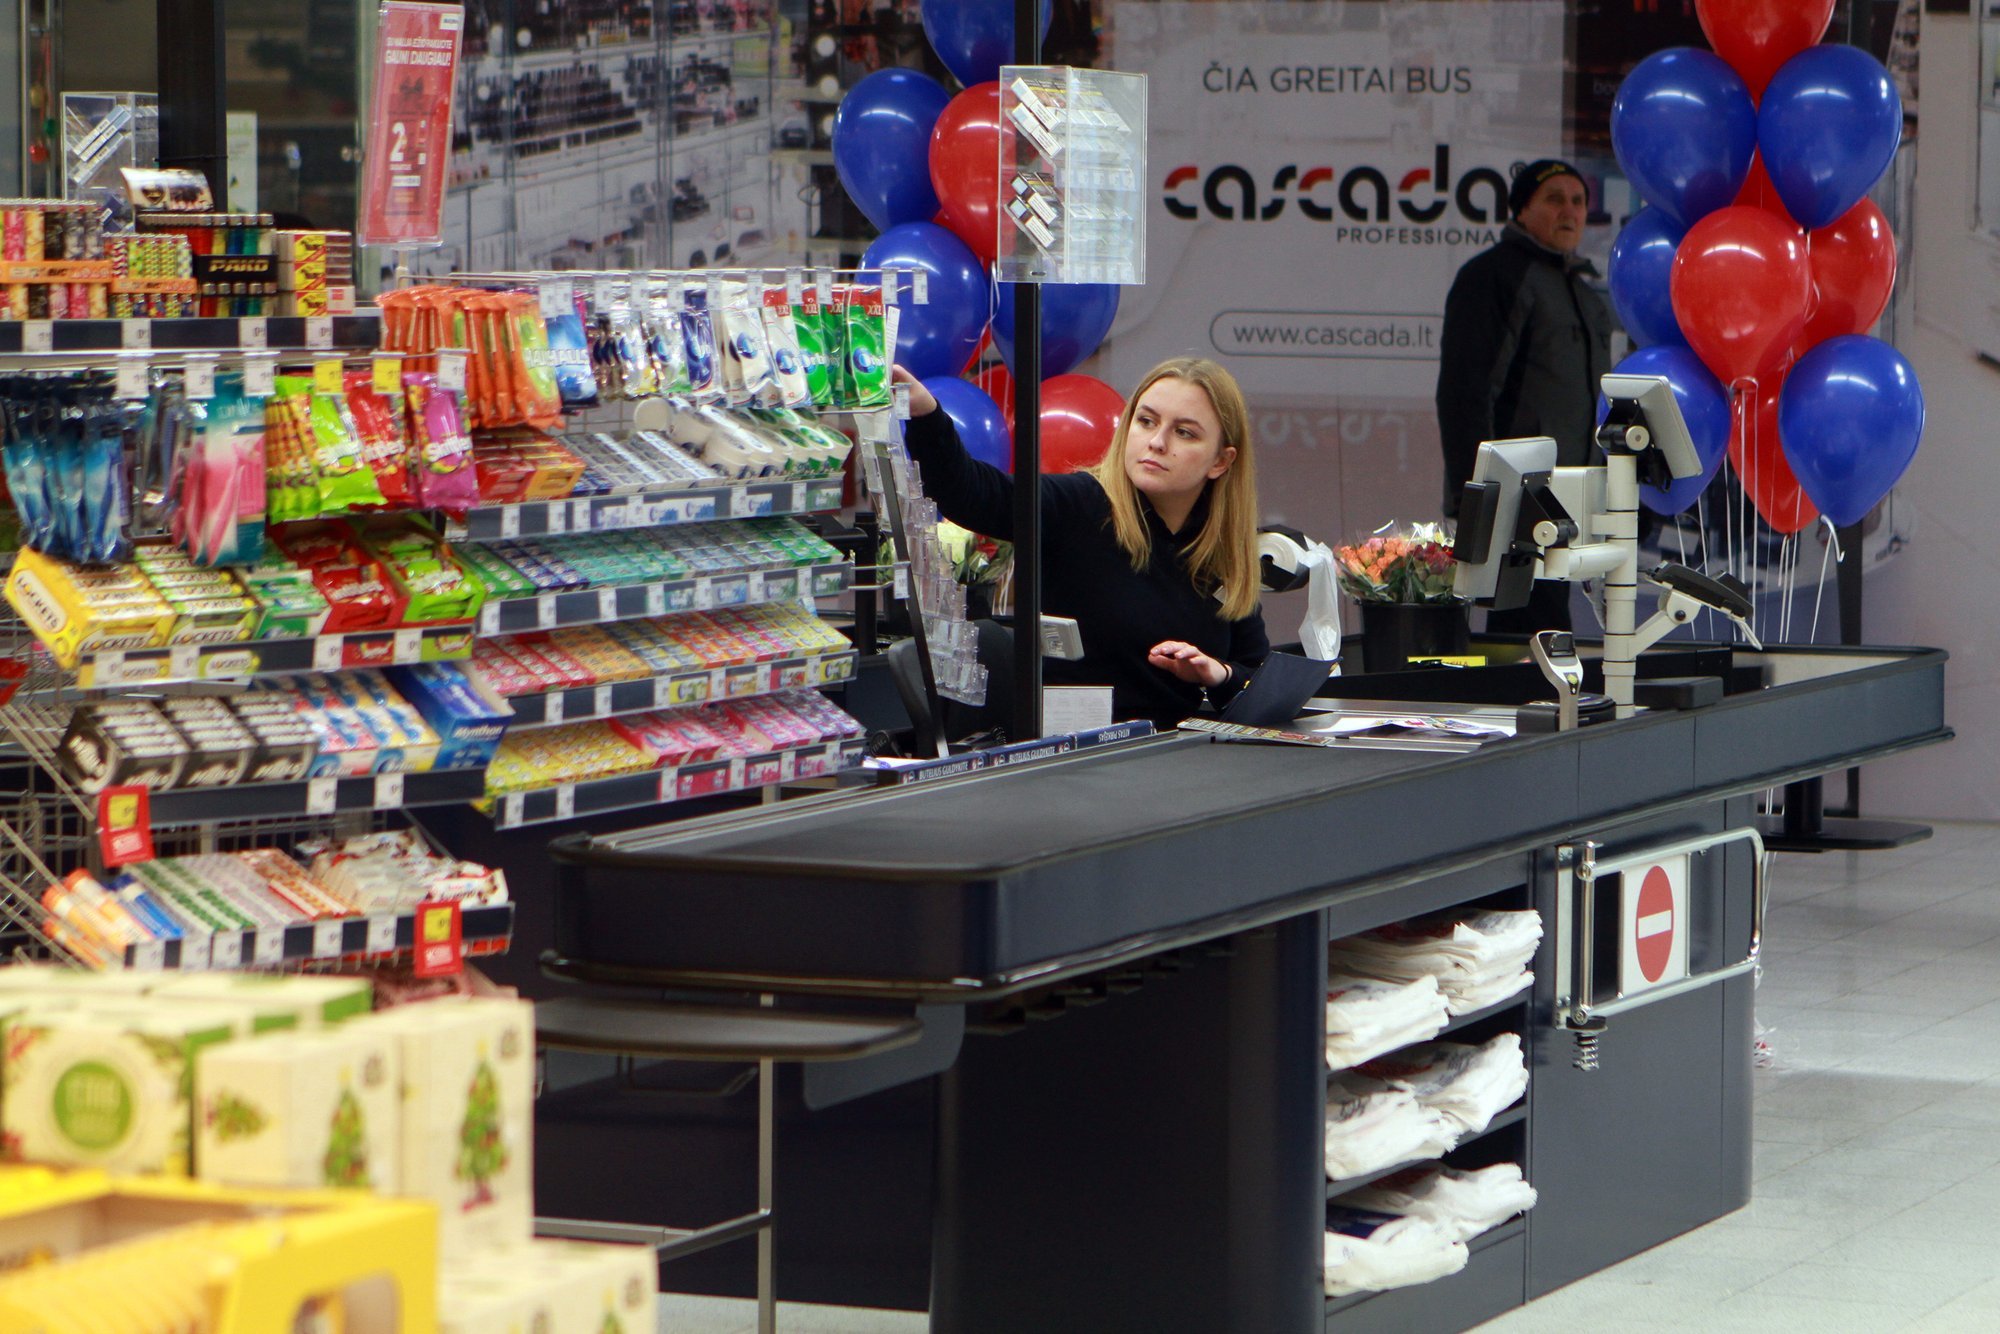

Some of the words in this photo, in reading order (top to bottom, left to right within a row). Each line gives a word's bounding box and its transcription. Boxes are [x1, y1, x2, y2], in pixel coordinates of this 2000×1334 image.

[1203, 61, 1258, 93] ČIA
[1270, 66, 1395, 93] GREITAI
[1406, 67, 1472, 94] BUS
[1163, 144, 1509, 223] cascada
[1337, 227, 1498, 246] PROFESSIONA
[1233, 323, 1433, 349] www.cascada.lt
[15, 575, 60, 630] LOCKETS
[80, 636, 146, 651] LOCKETS
[171, 630, 235, 645] LOCKETS
[454, 725, 504, 738] Mynthon
[1009, 750, 1031, 763] BUTELIUS
[919, 767, 942, 781] BUTELIUS
[942, 760, 969, 777] GULDYKITE
